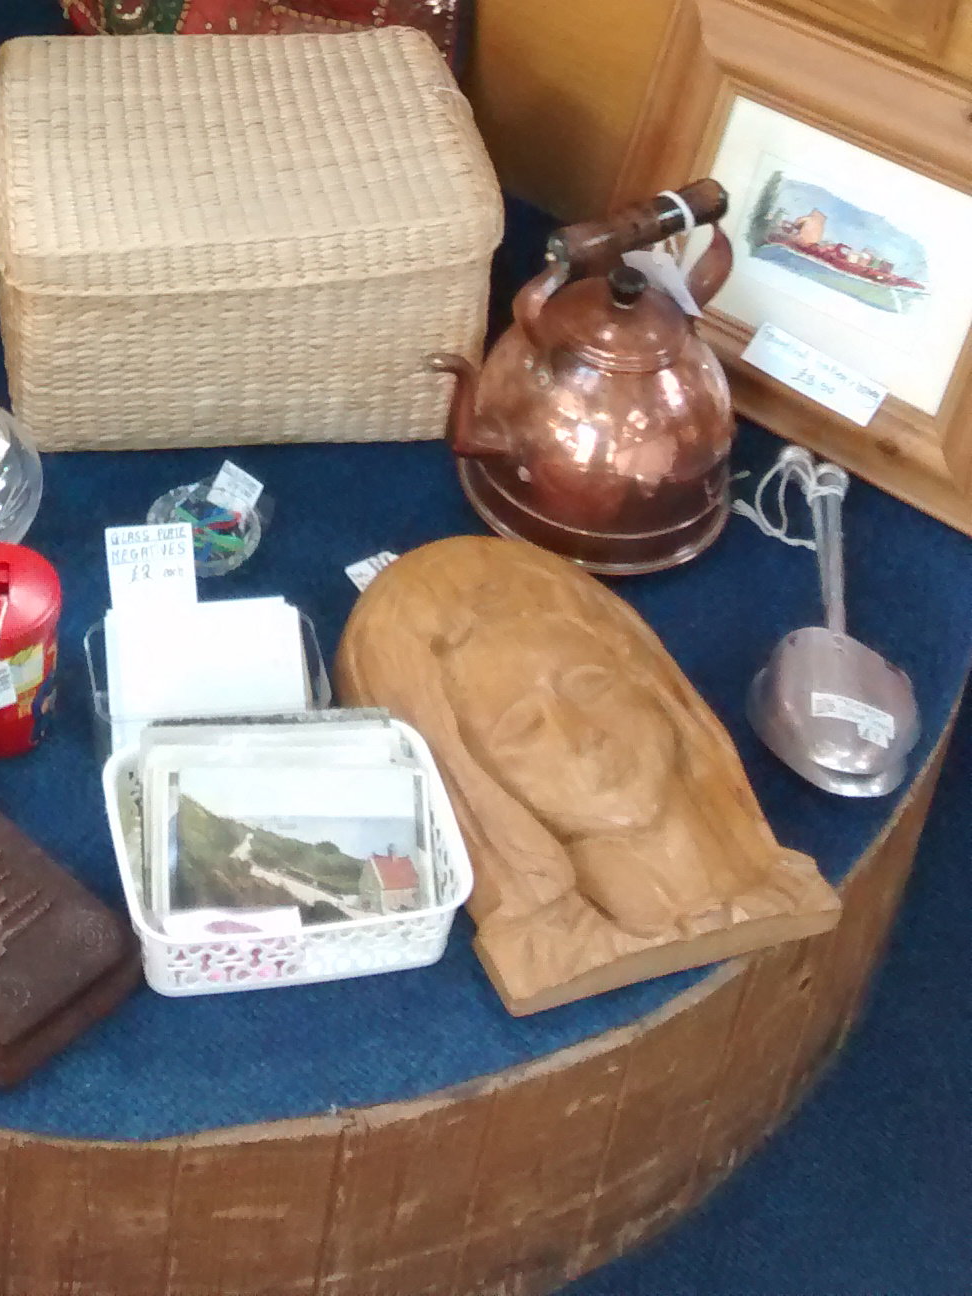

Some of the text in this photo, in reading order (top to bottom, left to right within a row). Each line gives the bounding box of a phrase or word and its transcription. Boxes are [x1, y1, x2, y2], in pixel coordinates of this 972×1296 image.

[110, 526, 187, 546] GLASS PLATE
[111, 542, 187, 565] NEGATIVES
